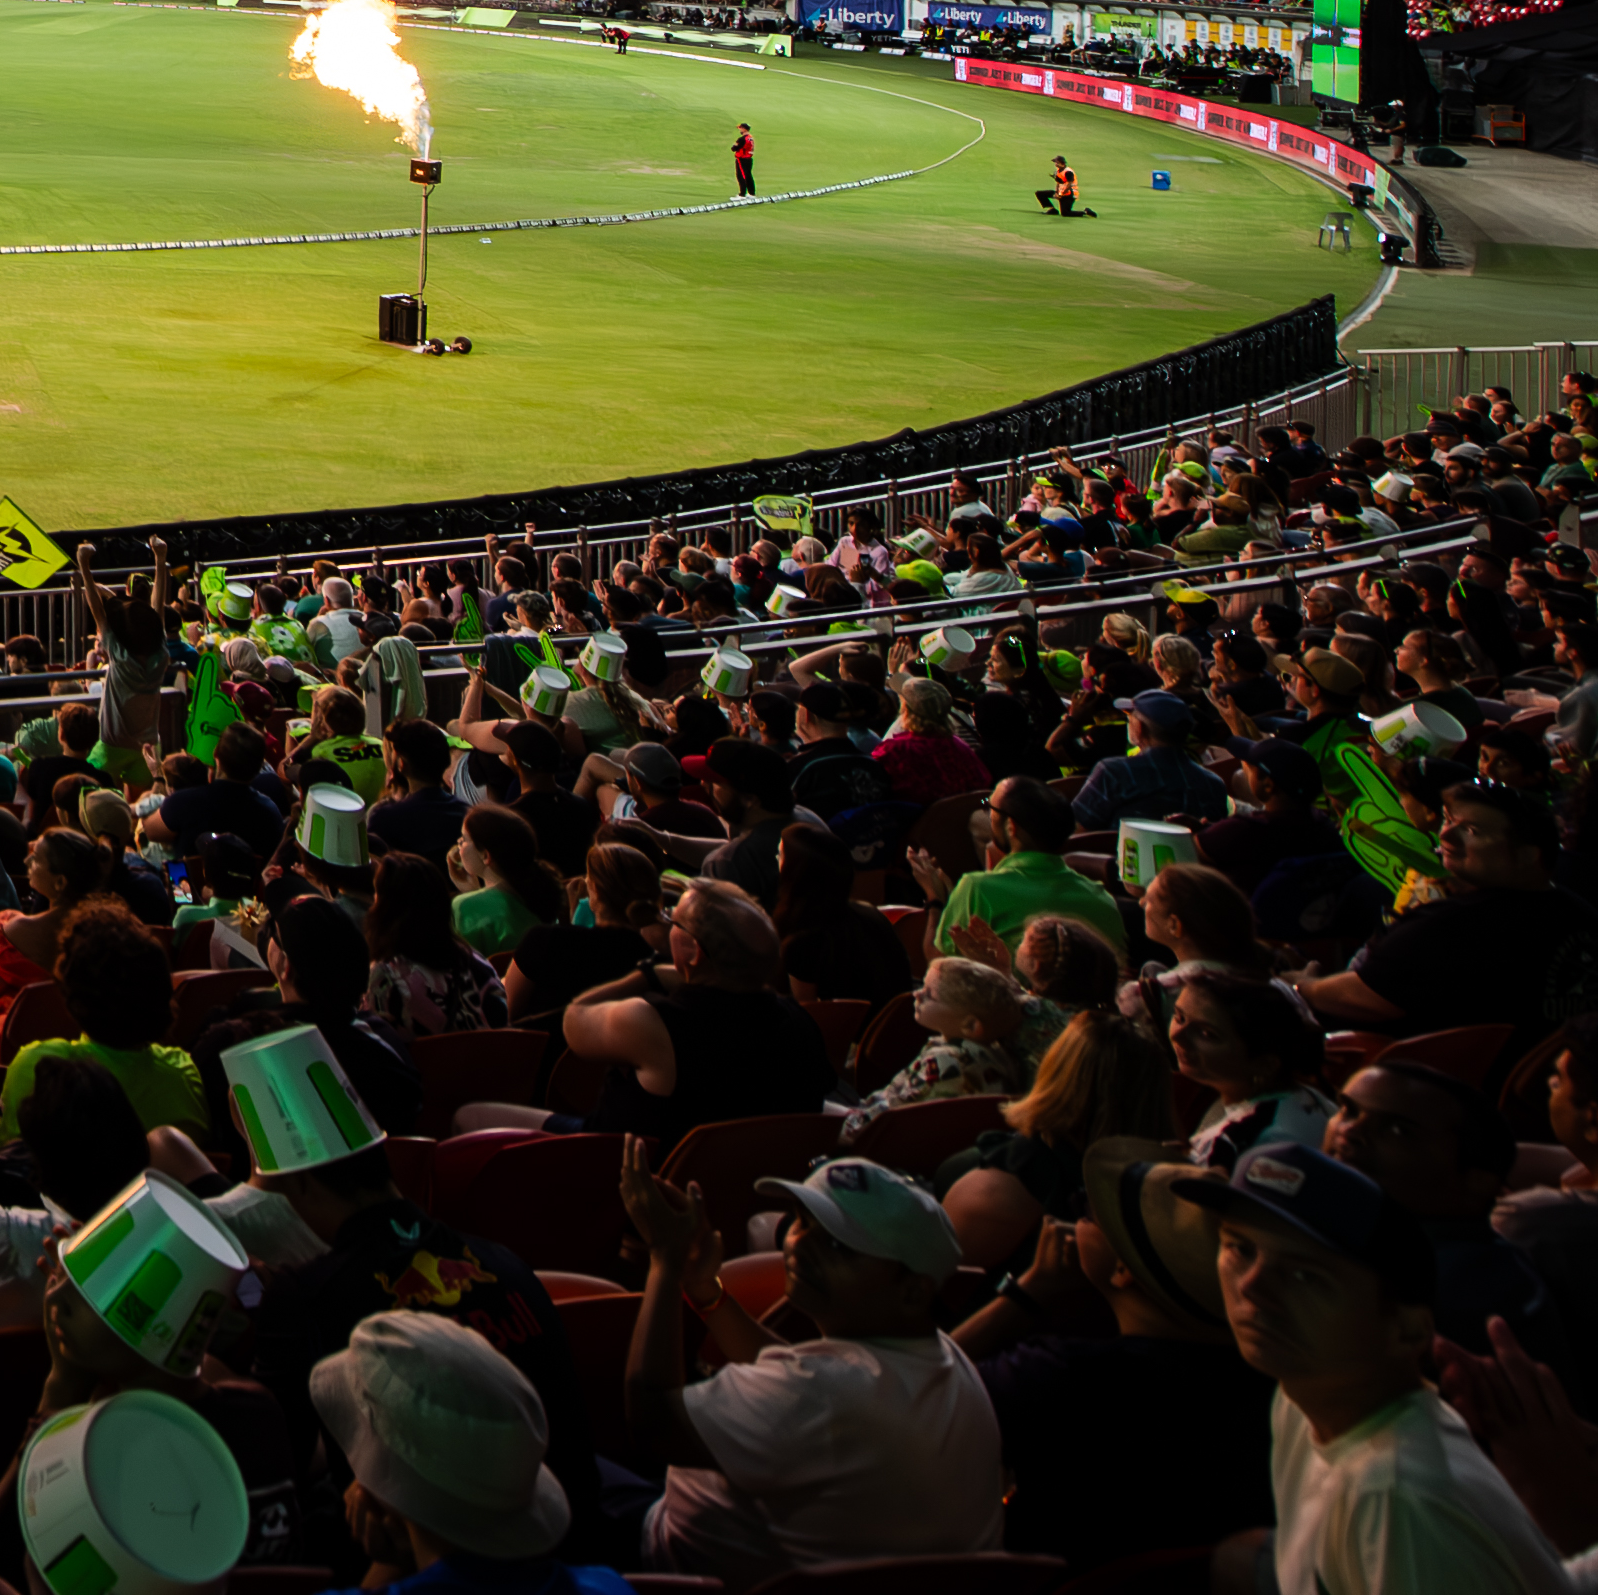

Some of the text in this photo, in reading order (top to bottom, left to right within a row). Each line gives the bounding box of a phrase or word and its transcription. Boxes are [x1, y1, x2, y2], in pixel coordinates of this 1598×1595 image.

[828, 8, 894, 29] Liberty
[944, 7, 982, 23] Liberty
[1007, 11, 1046, 29] Liberty
[871, 34, 892, 42] YETI
[951, 44, 971, 54] YETI
